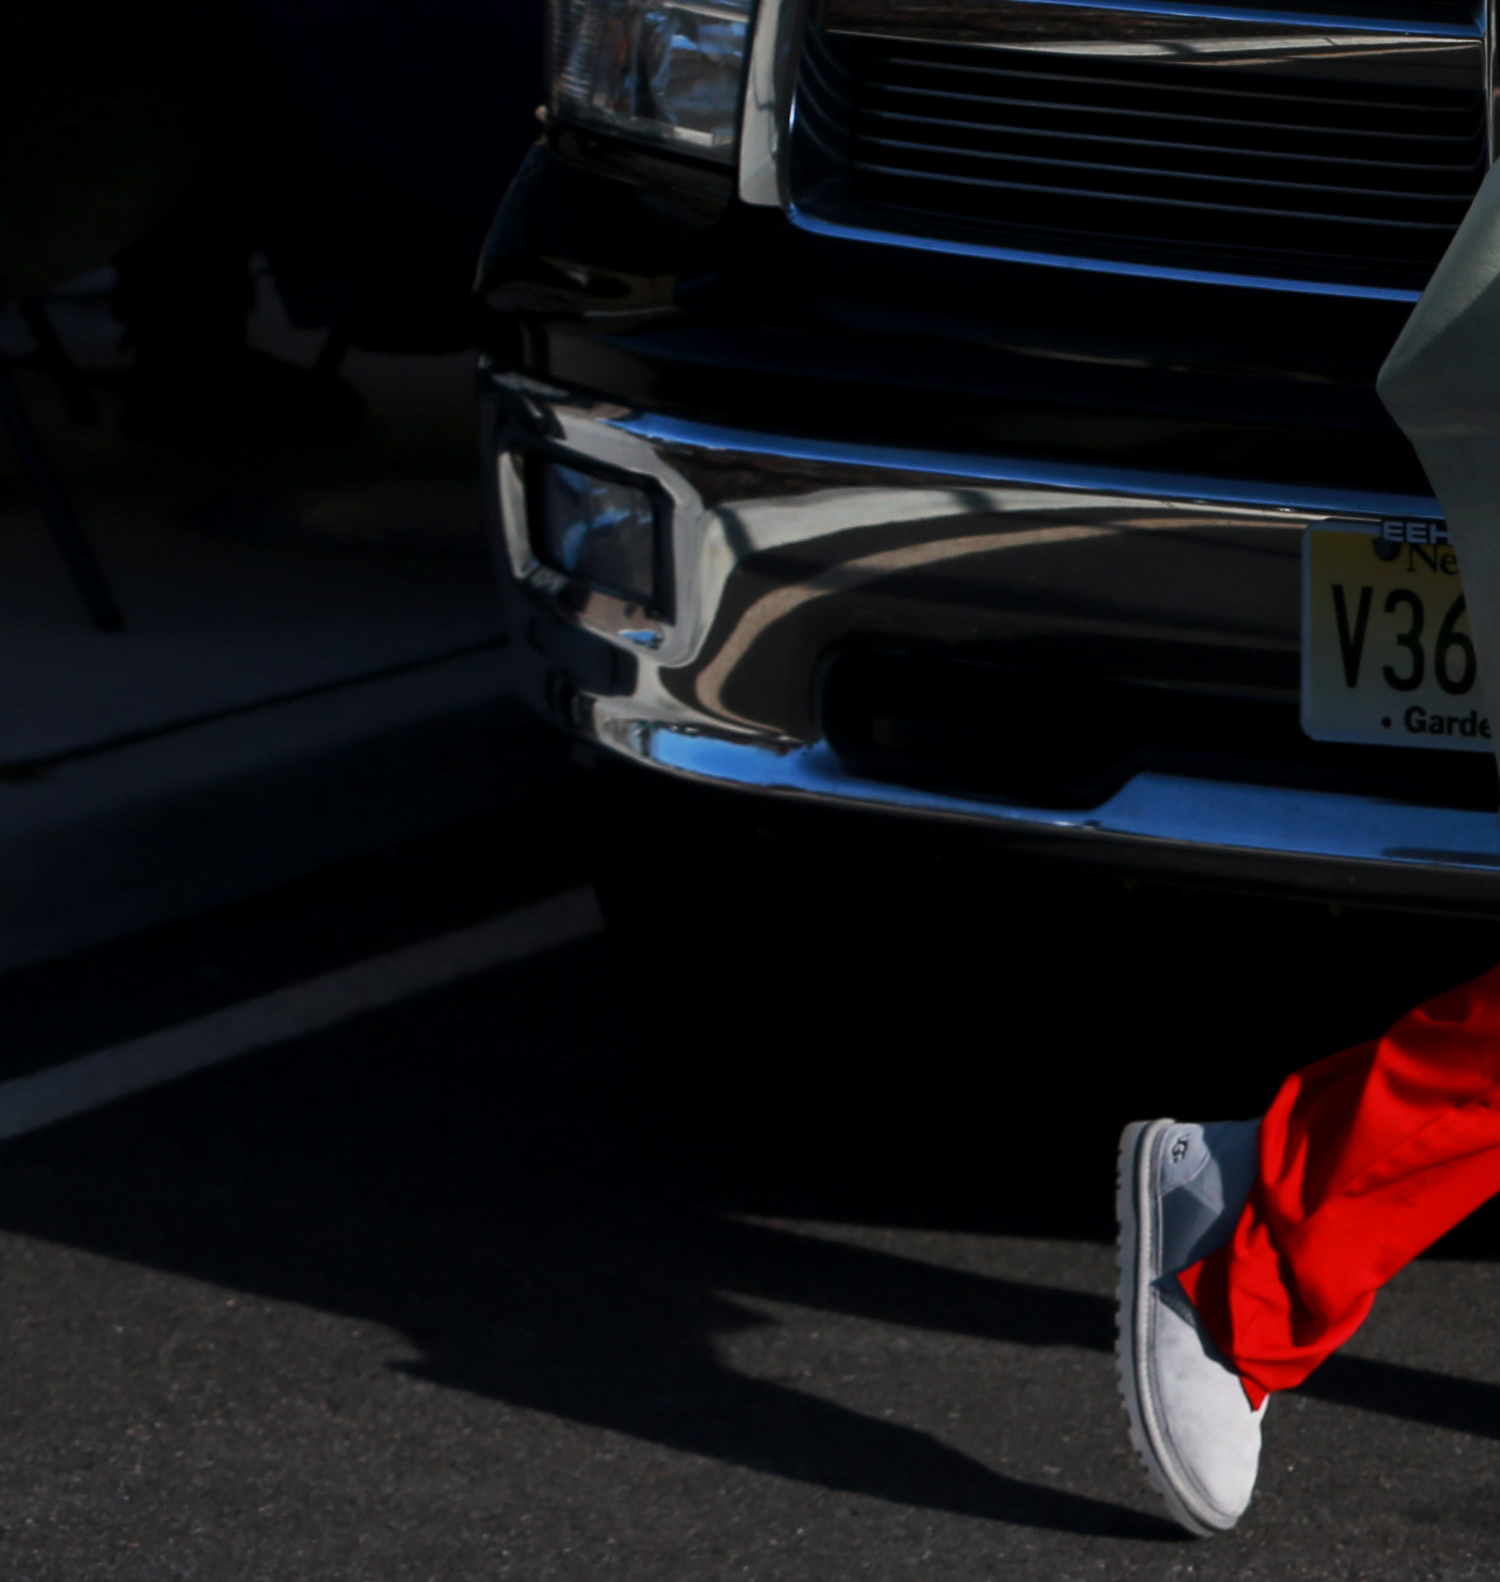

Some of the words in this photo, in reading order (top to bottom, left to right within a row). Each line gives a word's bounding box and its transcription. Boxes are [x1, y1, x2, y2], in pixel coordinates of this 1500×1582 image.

[1383, 521, 1453, 546] EEH
[1407, 543, 1459, 575] Ne
[1332, 583, 1477, 695] V36
[1405, 705, 1492, 739] Garde
